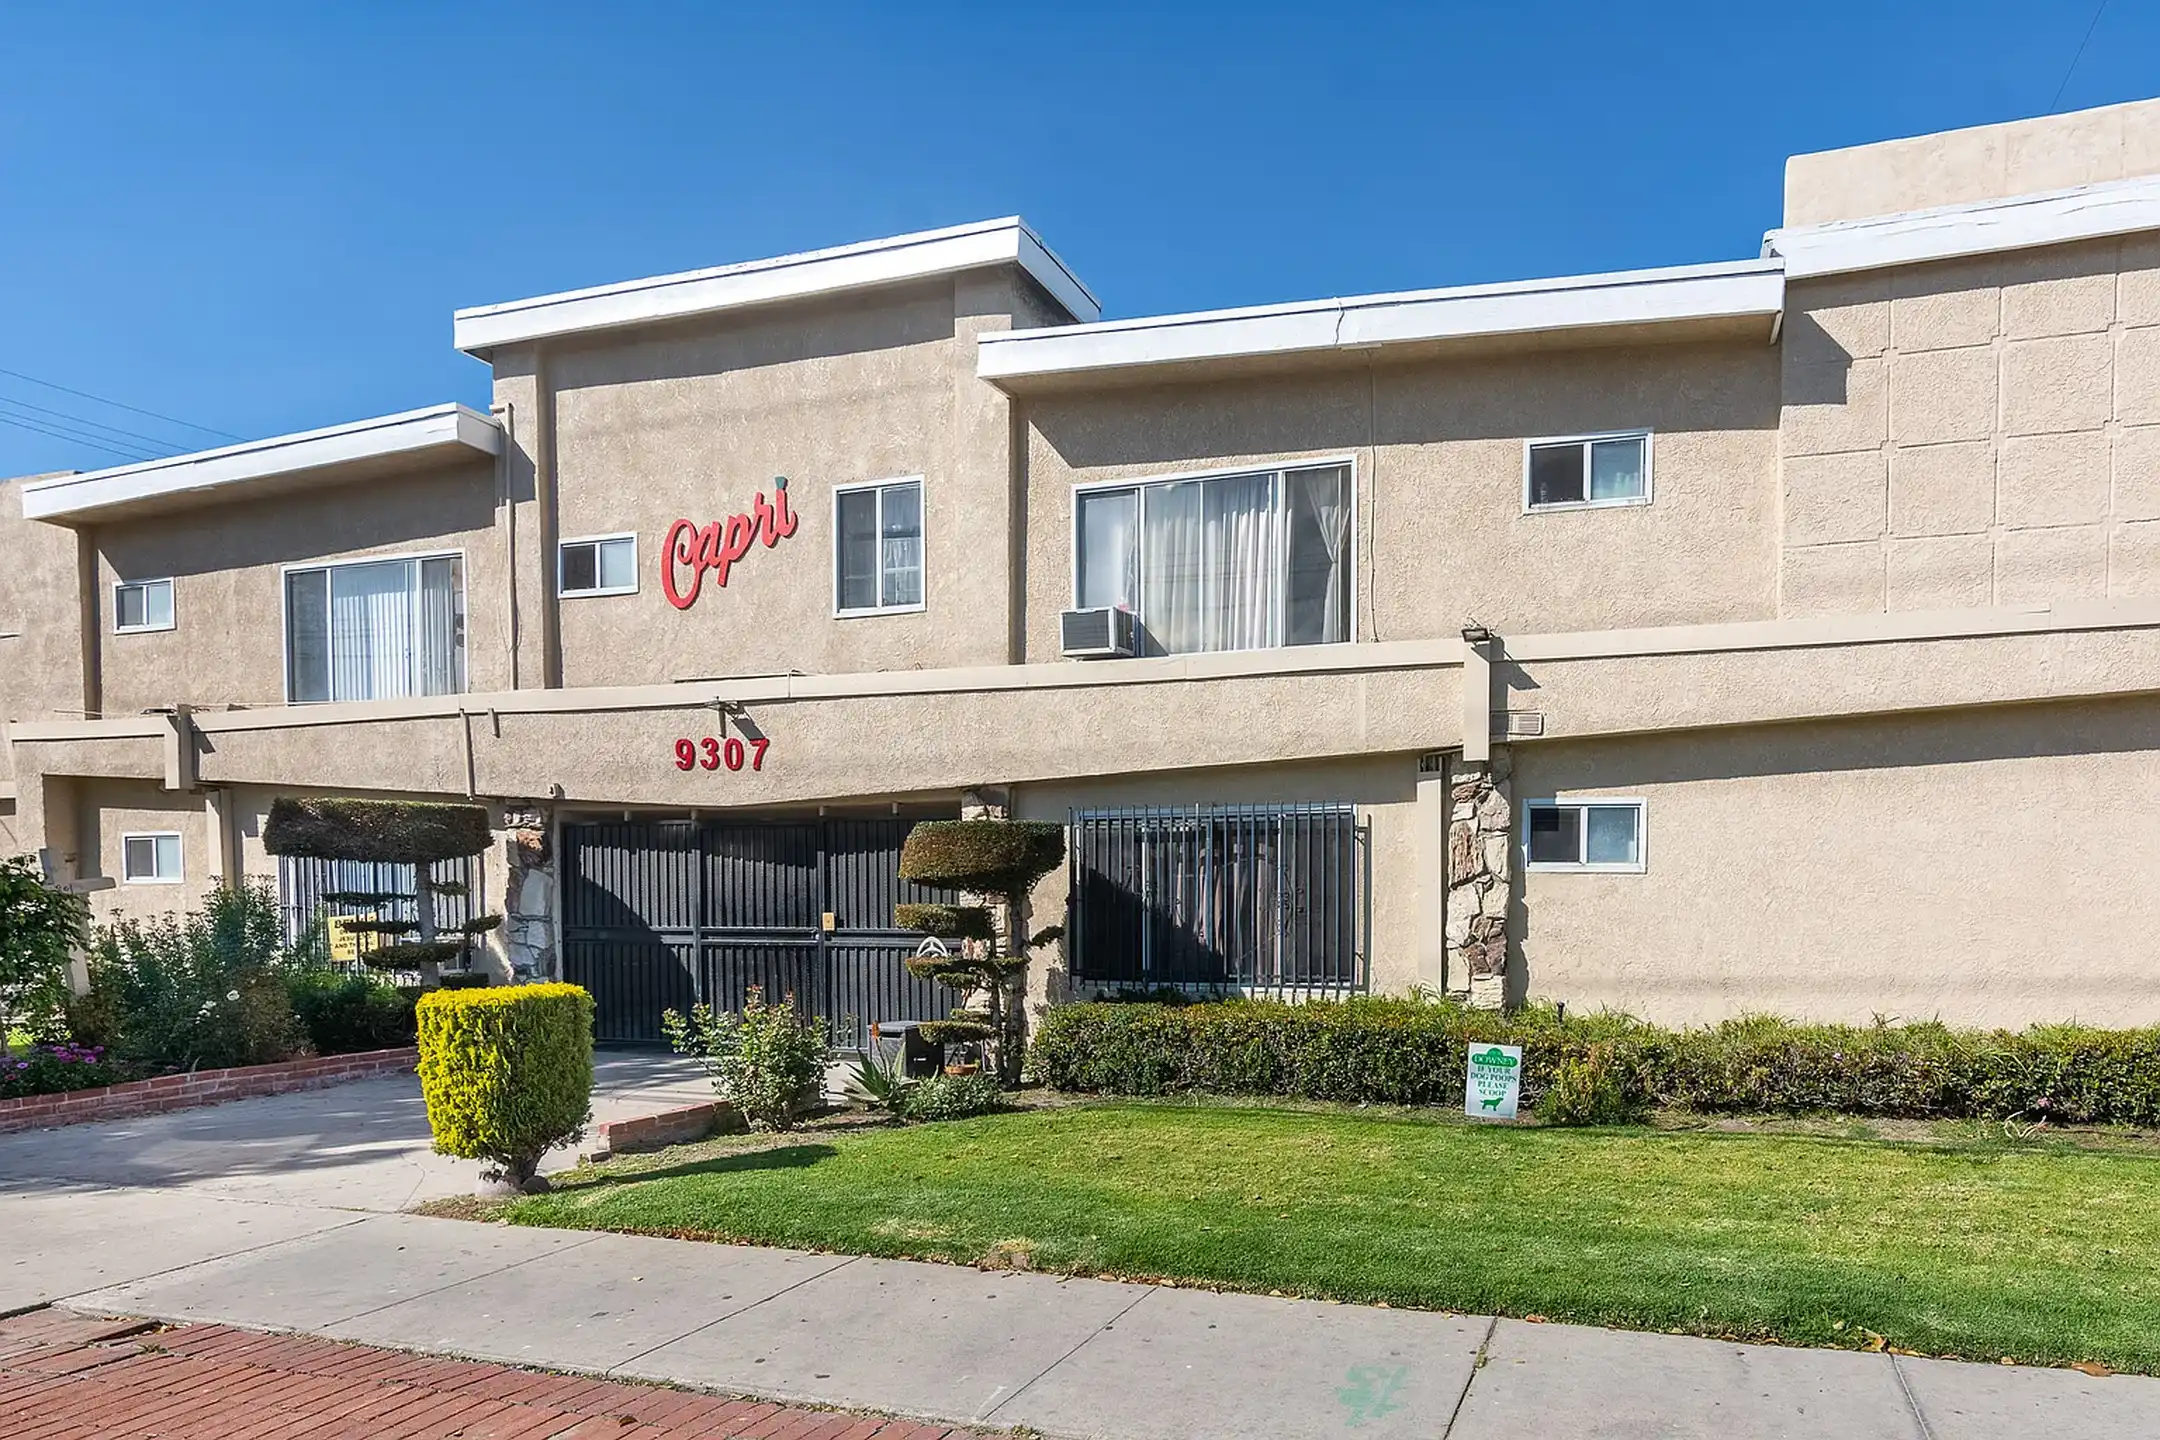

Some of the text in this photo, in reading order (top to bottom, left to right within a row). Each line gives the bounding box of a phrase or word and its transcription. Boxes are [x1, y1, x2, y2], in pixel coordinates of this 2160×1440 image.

[661, 476, 798, 610] Capri
[675, 737, 770, 771] 9307
[1474, 1055, 1516, 1066] DOWNEY
[1488, 1066, 1511, 1074] YOUR
[1470, 1072, 1517, 1083] DOG POOPS
[1477, 1081, 1508, 1089] PLEASE
[1478, 1089, 1507, 1097] SCOOP
